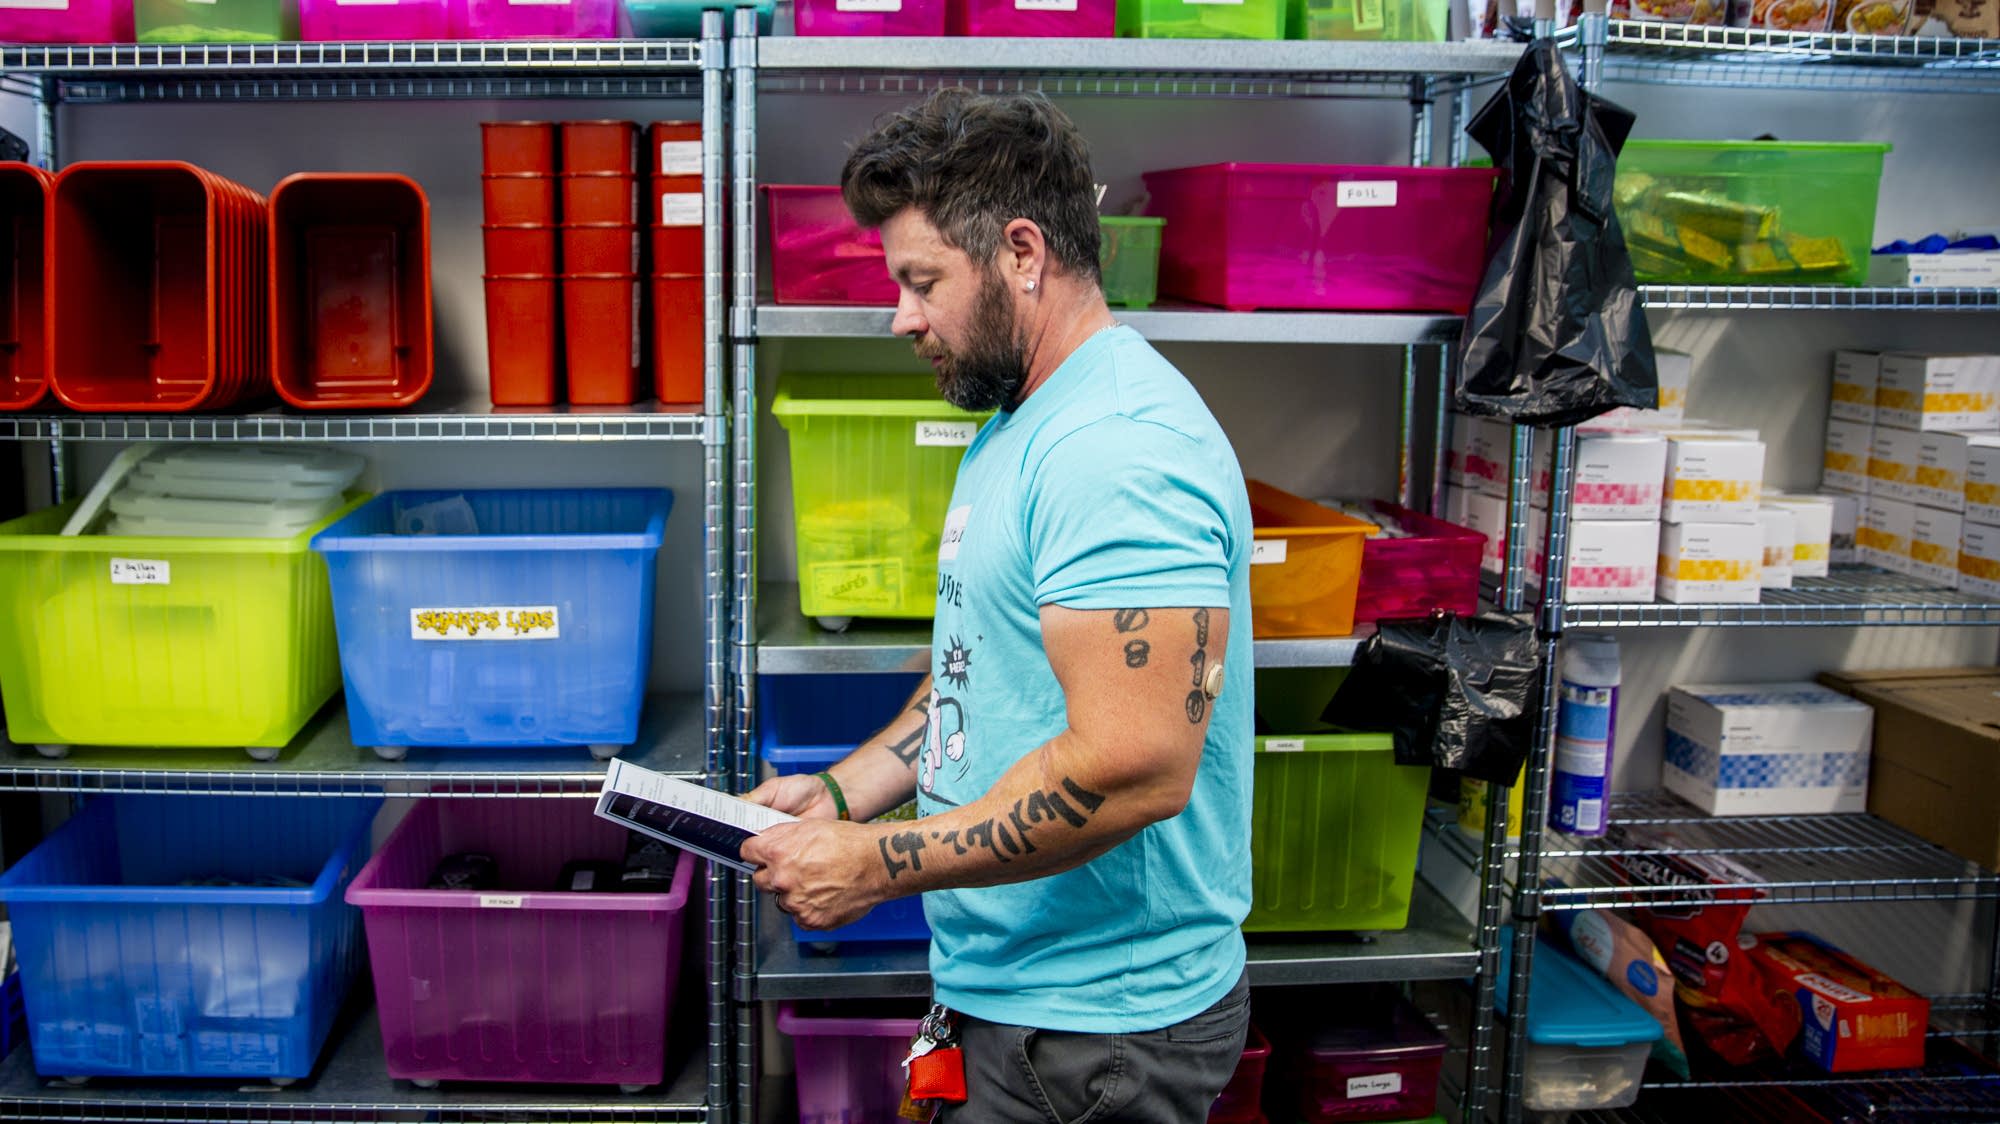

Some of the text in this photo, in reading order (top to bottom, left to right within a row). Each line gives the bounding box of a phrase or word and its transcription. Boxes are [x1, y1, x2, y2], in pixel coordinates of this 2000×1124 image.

[1347, 188, 1378, 199] FOIL
[923, 426, 966, 439] Bubbles
[416, 610, 555, 636] SHARPS LIDS
